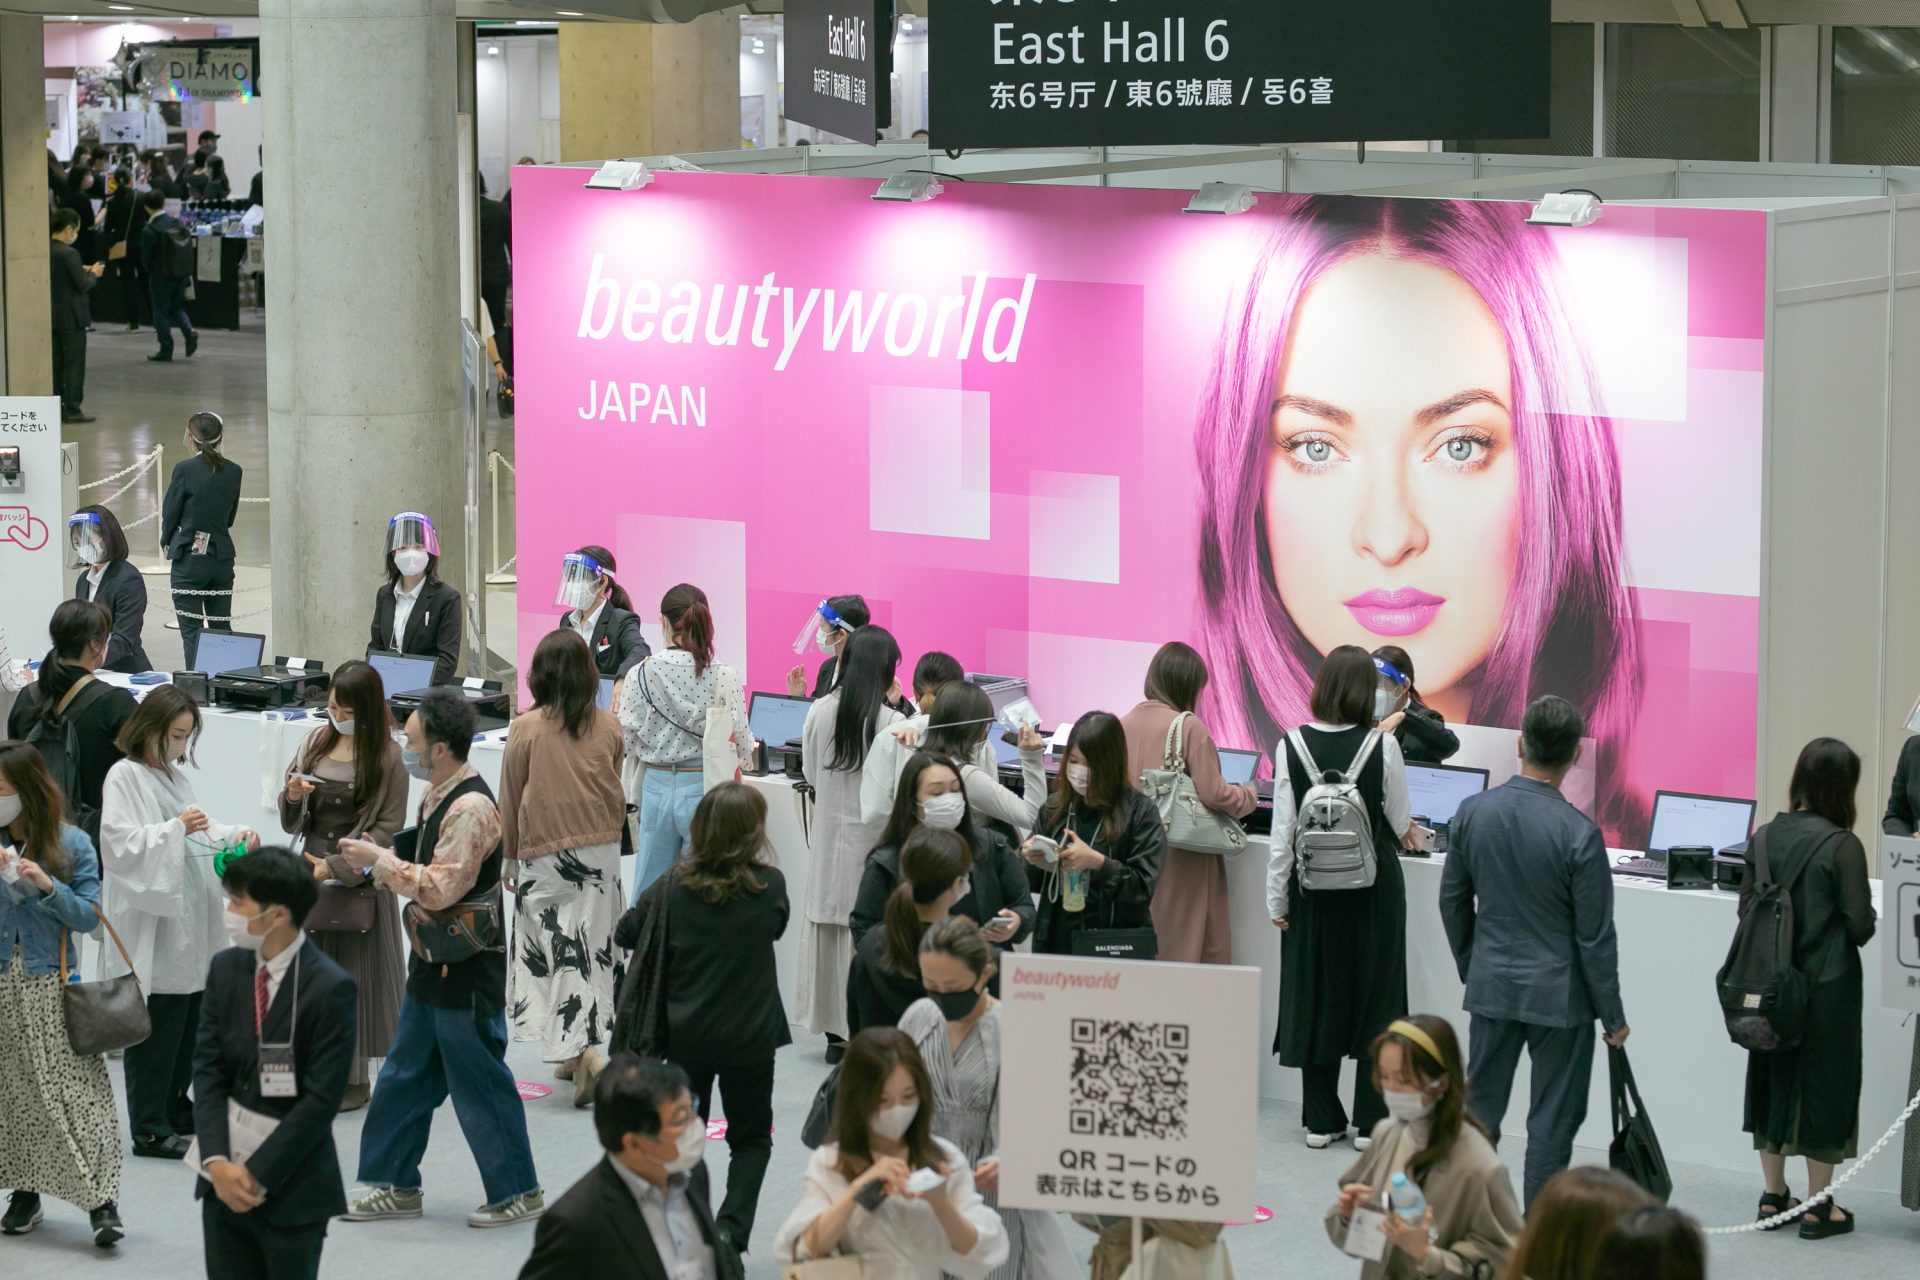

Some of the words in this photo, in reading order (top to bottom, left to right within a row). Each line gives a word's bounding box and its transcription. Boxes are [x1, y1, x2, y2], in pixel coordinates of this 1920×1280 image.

[828, 14, 843, 57] East
[844, 16, 859, 60] Hall
[860, 20, 866, 61] 6
[993, 22, 1085, 65] East
[1103, 17, 1185, 63] Hall
[1204, 19, 1230, 62] 6
[170, 62, 248, 80] DIAMO
[989, 81, 1096, 109] 东6号厅
[1104, 79, 1118, 108] /
[1126, 78, 1233, 108] 東6號廳
[1240, 77, 1254, 106] /
[1262, 76, 1334, 105] 동6홀
[577, 252, 1037, 371] beautyworld
[0, 411, 37, 421] コードを
[577, 379, 707, 427] JAPAN
[0, 423, 48, 432] てください
[1012, 966, 1121, 991] beautyworld
[1059, 1149, 1096, 1171] QR
[1106, 1153, 1198, 1177] コードの
[1036, 1174, 1221, 1207] 表示はこちらから
